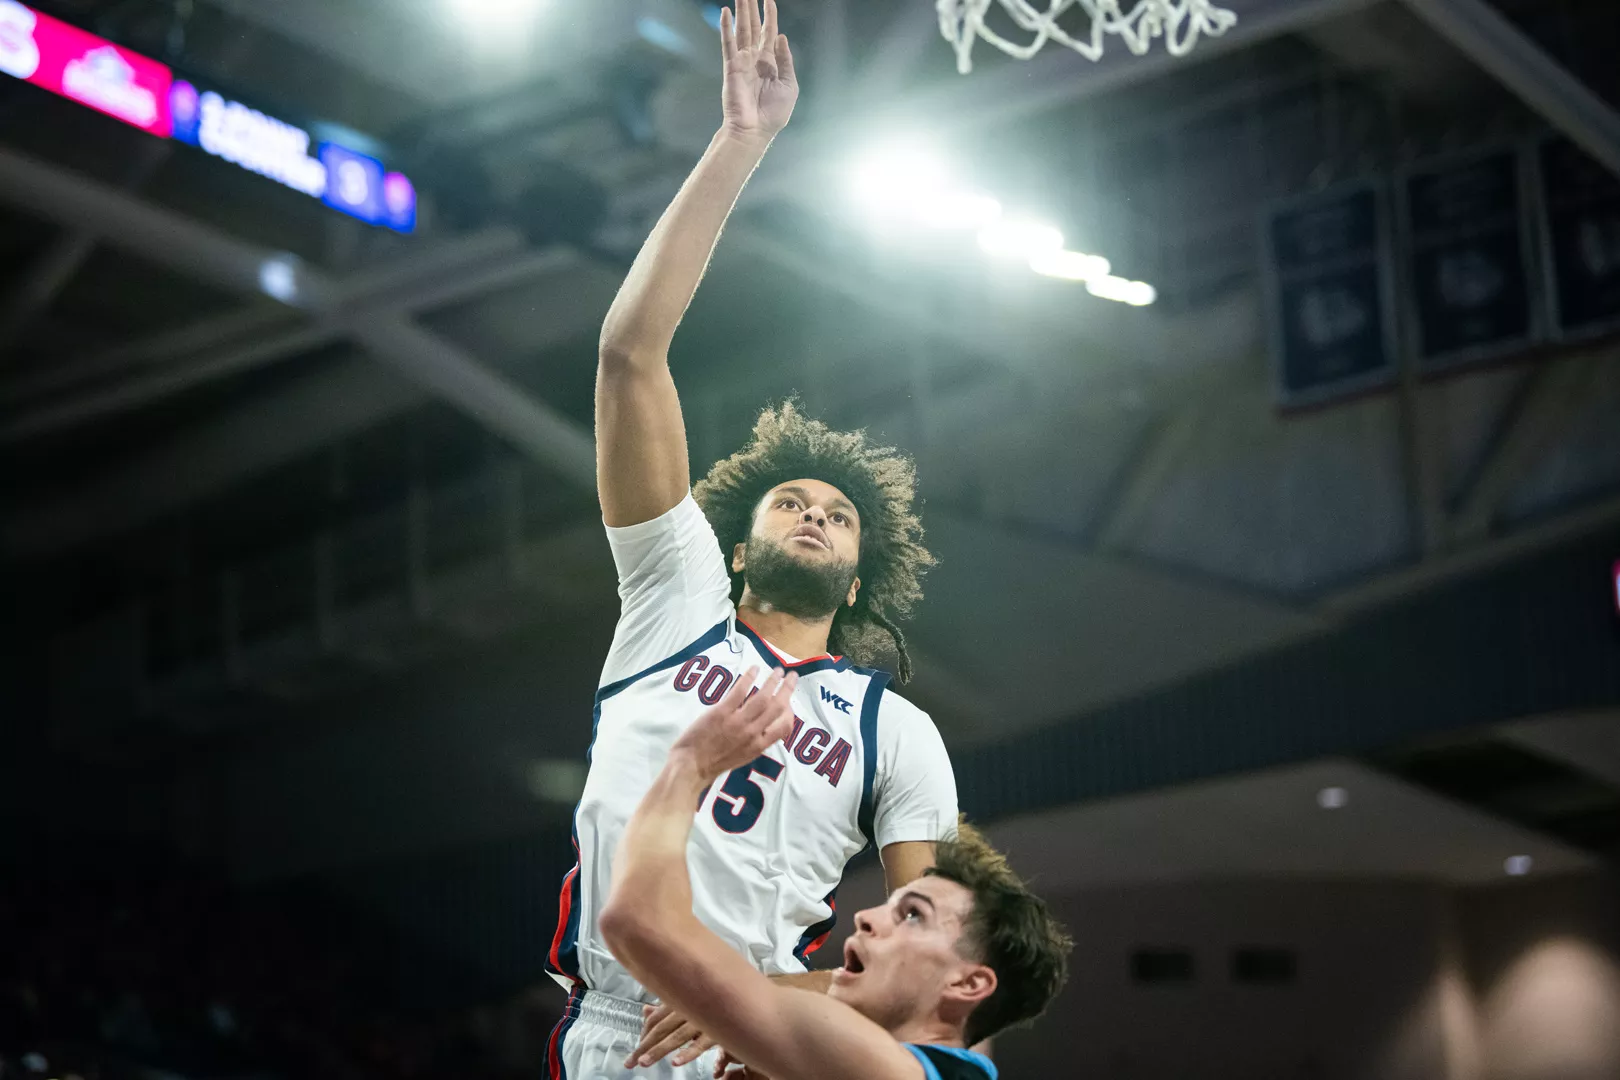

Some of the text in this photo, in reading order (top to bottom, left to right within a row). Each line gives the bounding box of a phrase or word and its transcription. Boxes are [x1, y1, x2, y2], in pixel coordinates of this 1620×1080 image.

[673, 655, 852, 788] GOGA
[820, 685, 854, 715] WCC
[696, 753, 785, 834] 5
